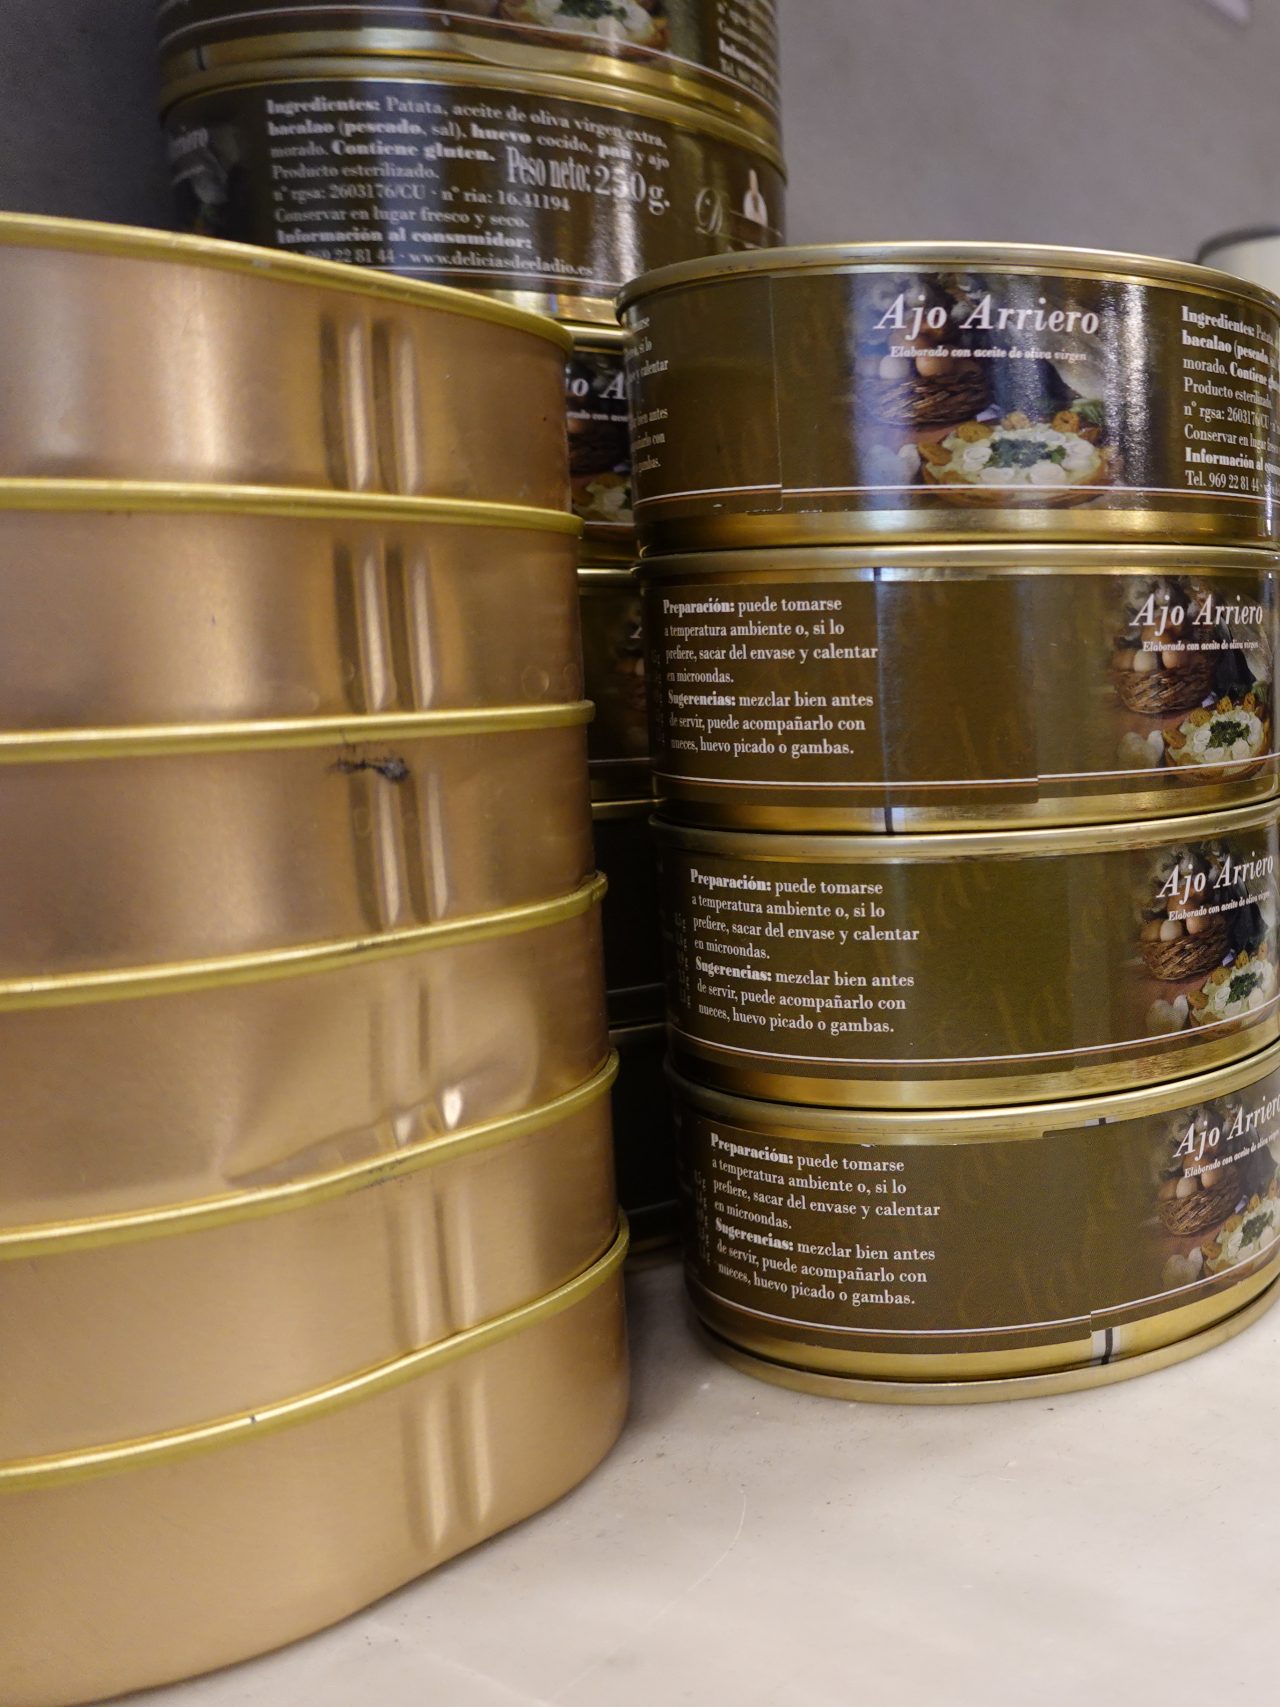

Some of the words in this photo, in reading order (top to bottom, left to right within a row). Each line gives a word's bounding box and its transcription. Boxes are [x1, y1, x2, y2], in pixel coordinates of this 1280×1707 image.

[266, 96, 380, 115] Ingredientes:
[453, 102, 500, 117] aceite
[506, 105, 526, 122] de
[530, 110, 570, 128] oliva
[331, 140, 418, 155] Contiene
[423, 142, 495, 161] gluten.
[648, 153, 669, 171] ajo
[506, 146, 547, 186] Peso
[549, 156, 591, 192] neto:
[373, 205, 415, 227] lugar
[420, 207, 469, 224] fresco
[474, 212, 485, 228] y
[873, 293, 947, 341] Ajo
[959, 293, 1099, 334] Arriero
[1181, 305, 1255, 337] Ingredientes:
[1182, 330, 1232, 352] bacalao
[890, 346, 947, 358] Elaborado
[951, 348, 971, 358] con
[974, 346, 1006, 358] aceite
[1008, 347, 1022, 358] de
[1054, 348, 1087, 363] virgen
[1183, 358, 1227, 375] morado.
[1230, 361, 1267, 386] Contiene
[1184, 377, 1233, 399] Producto
[1200, 406, 1225, 422] rgsa:
[1184, 424, 1237, 445] Conservar
[1239, 435, 1249, 446] en
[1185, 447, 1254, 469] Información
[1185, 470, 1206, 486] Tel.
[1209, 472, 1226, 488] 969
[1229, 475, 1238, 489] 22
[1241, 476, 1249, 490] 81
[663, 598, 735, 618] Preparación:
[738, 597, 778, 617] puede
[782, 599, 842, 611] tomarse
[1129, 593, 1184, 636] Ajo
[1192, 594, 1263, 626] Arriero
[670, 625, 727, 641] temperatura
[730, 621, 791, 636] ambiente
[796, 625, 809, 637] o,
[813, 621, 825, 635] si
[830, 619, 844, 635] lo
[699, 649, 726, 659] sacar
[729, 644, 747, 659] del
[750, 649, 795, 659] envase
[800, 649, 809, 663] y
[813, 643, 878, 658] calentar
[1143, 640, 1185, 651] Elaborado
[1201, 640, 1220, 650] aceite
[1221, 640, 1228, 649] de
[677, 668, 734, 683] microondas.
[668, 690, 736, 708] Sugerencias:
[739, 691, 791, 707] mezclar
[795, 691, 826, 706] bien
[832, 693, 874, 706] antes
[679, 714, 705, 730] servir,
[707, 714, 739, 733] puede
[742, 715, 833, 735] acompañarlo
[838, 720, 865, 730] con
[700, 737, 730, 752] huevo
[733, 739, 775, 757] picado
[779, 742, 787, 753] o
[791, 739, 854, 759] gambas.
[690, 869, 772, 891] Preparación:
[775, 878, 816, 896] puede
[820, 881, 883, 895] tomarse
[1156, 863, 1206, 905] Ajo
[1213, 851, 1273, 889] Arriero
[692, 896, 696, 904] a
[698, 895, 762, 914] temperatura
[766, 901, 831, 916] ambiente
[836, 907, 849, 919] o,
[853, 904, 865, 917] si
[870, 903, 885, 917] lo
[1169, 906, 1207, 922] Elaborado
[1208, 906, 1219, 914] con
[1221, 898, 1237, 911] aceite
[1239, 896, 1245, 907] de
[693, 915, 729, 934] prefiere,
[732, 924, 761, 936] sacar
[765, 922, 784, 938] del
[787, 928, 835, 939] envase
[840, 929, 849, 944] y
[853, 926, 920, 941] calentar
[694, 939, 704, 950] en
[706, 942, 770, 959] microondas.
[695, 956, 772, 981] Sugerencias:
[775, 970, 830, 985] mezclar
[834, 971, 867, 986] bien
[872, 974, 914, 986] antes
[697, 979, 707, 993] de
[708, 985, 737, 1001] servir,
[741, 989, 775, 1005] puede
[779, 995, 873, 1012] acompañarlo
[878, 999, 906, 1009] con
[733, 1008, 766, 1025] huevo
[769, 1014, 813, 1031] picado
[818, 1020, 826, 1030] o
[831, 1017, 894, 1036] gambas.
[710, 1132, 793, 1164] Preparación:
[797, 1154, 838, 1171] puede
[842, 1157, 905, 1172] tomarse
[1173, 1121, 1220, 1161] Ajo
[1184, 1158, 1221, 1179] Elaborado
[1222, 1155, 1233, 1166] con
[1234, 1147, 1250, 1161] aceite
[1251, 1143, 1256, 1152] de
[712, 1158, 717, 1167] a
[719, 1159, 784, 1185] temperatura
[788, 1174, 852, 1192] ambiente
[857, 1183, 871, 1196] o,
[875, 1180, 887, 1194] si
[892, 1179, 907, 1194] lo
[713, 1178, 750, 1201] prefiere,
[753, 1192, 783, 1206] sacar
[787, 1194, 806, 1210] del
[810, 1202, 856, 1214] envase
[861, 1204, 871, 1220] y
[875, 1202, 940, 1216] calentar
[714, 1201, 724, 1212] en
[726, 1203, 792, 1229] microondas.
[715, 1217, 793, 1251] Sugerencias:
[797, 1241, 852, 1258] mezclar
[856, 1244, 888, 1260] bien
[893, 1248, 935, 1260] antes
[717, 1239, 727, 1253] de
[729, 1244, 759, 1266] servir,
[762, 1257, 797, 1273] puede
[801, 1266, 895, 1284] acompañarlo
[899, 1271, 927, 1282] con
[754, 1272, 788, 1293] huevo
[791, 1283, 835, 1300] picado
[839, 1291, 847, 1300] o
[852, 1290, 915, 1306] gambas.
